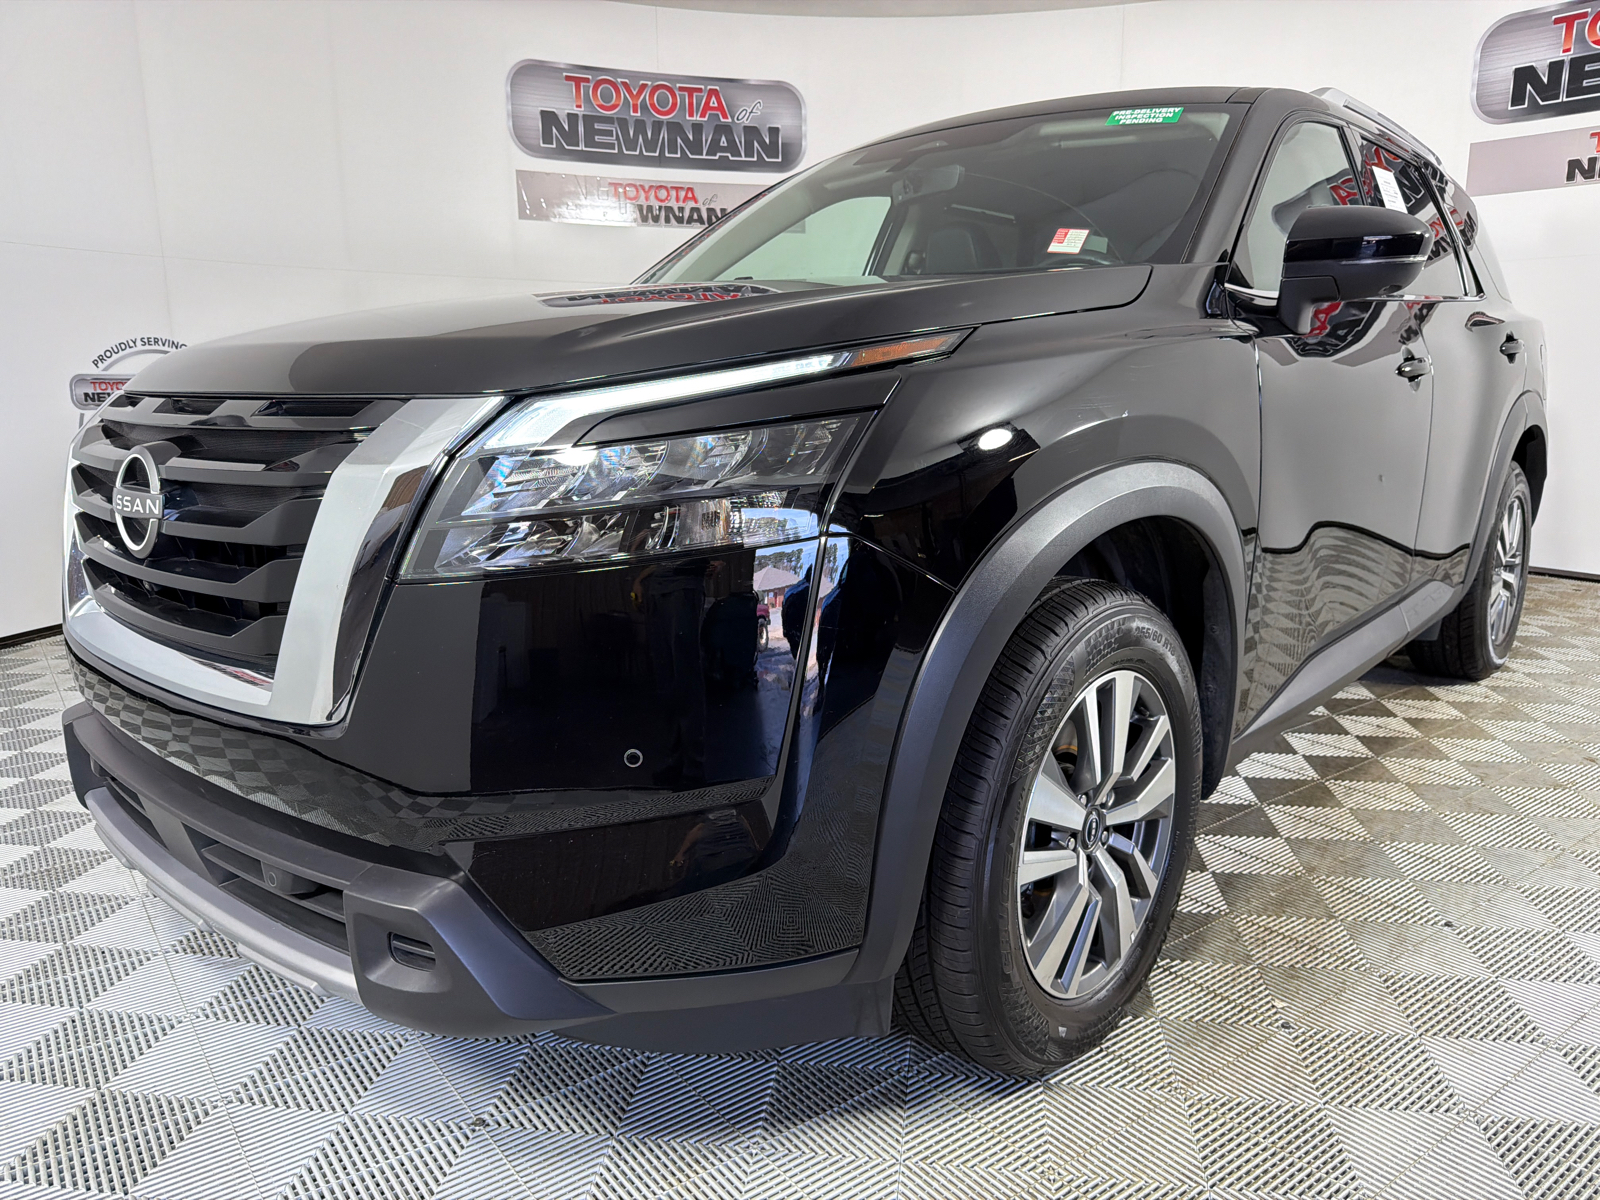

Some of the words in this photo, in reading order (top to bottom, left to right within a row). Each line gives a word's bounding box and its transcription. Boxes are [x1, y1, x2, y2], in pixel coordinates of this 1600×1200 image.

[563, 73, 731, 122] TOYOTA
[734, 100, 762, 123] of
[1113, 107, 1181, 115] PRE-DELIVERY
[1115, 112, 1174, 120] INSPECTION
[539, 109, 782, 161] NEWNAN
[1565, 156, 1600, 184] N
[608, 182, 699, 205] TOYOTA
[702, 194, 718, 206] of
[636, 204, 727, 226] WNAN
[92, 338, 137, 369] PROUDLY
[90, 381, 127, 391] TOYO
[83, 392, 114, 403] NE
[116, 495, 159, 514] SSAN
[1134, 626, 1163, 644] 255/60
